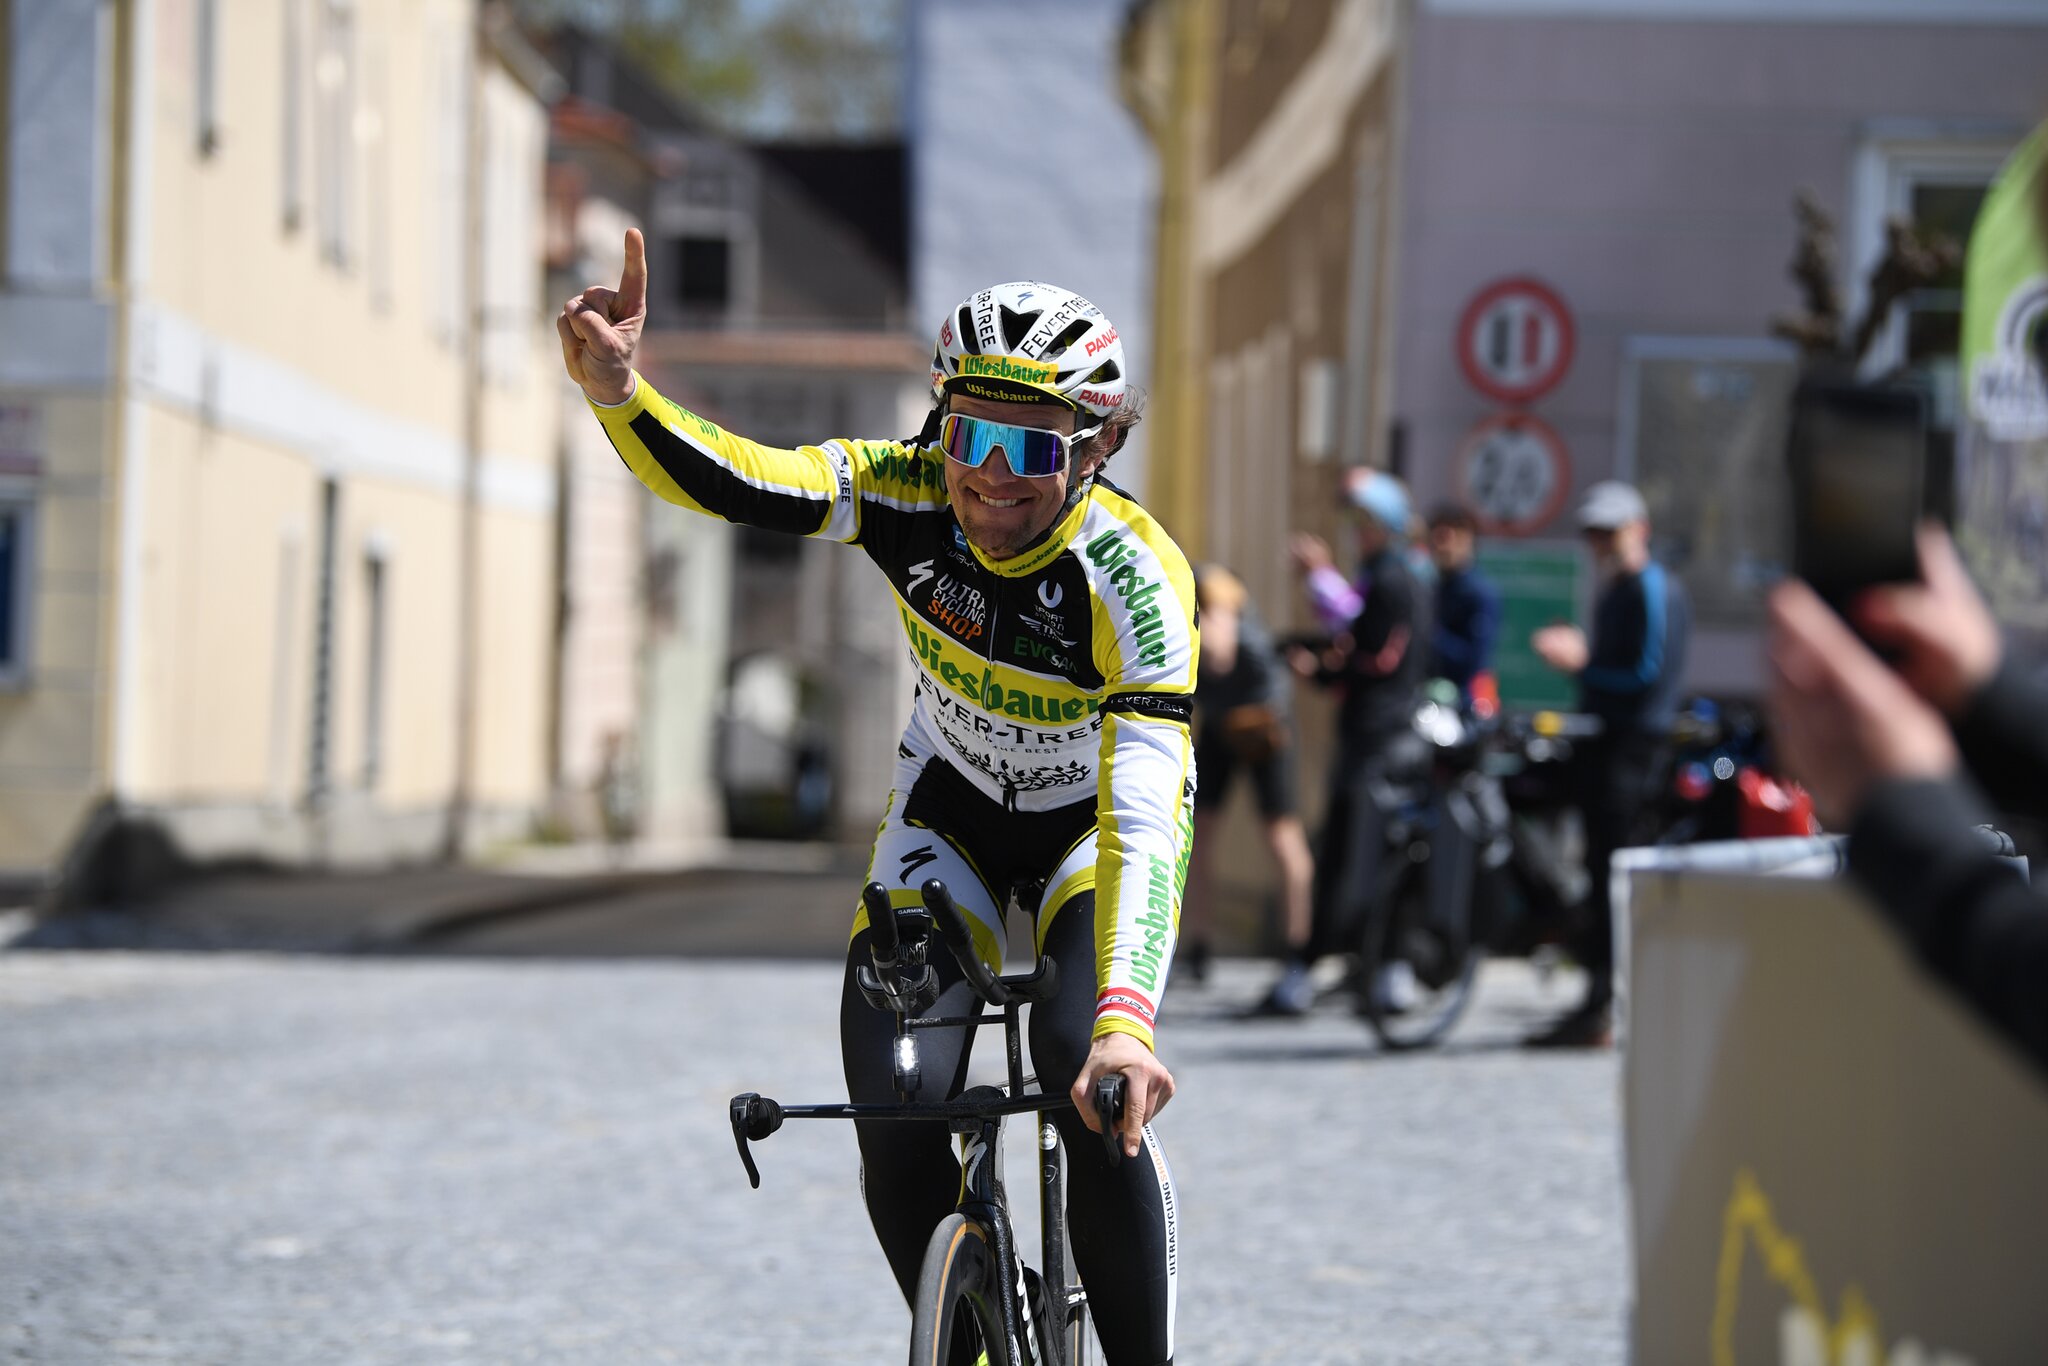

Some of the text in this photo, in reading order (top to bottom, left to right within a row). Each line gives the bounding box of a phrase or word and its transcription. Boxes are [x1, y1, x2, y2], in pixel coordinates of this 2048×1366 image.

[977, 290, 996, 349] ER-TREE
[964, 357, 1050, 385] Wiesbauer
[966, 382, 1041, 403] Wiesbauer
[1008, 536, 1065, 574] Wiesbauer
[932, 588, 986, 626] CYCLING
[937, 573, 986, 614] ULTRA
[1086, 529, 1168, 669] Wiesbauer
[927, 598, 983, 641] SHOP
[902, 606, 1104, 722] Wiesbauer
[908, 647, 1104, 744] FEVER-TREE
[1025, 747, 1059, 755] BEST
[1128, 853, 1170, 992] Wiesbauer
